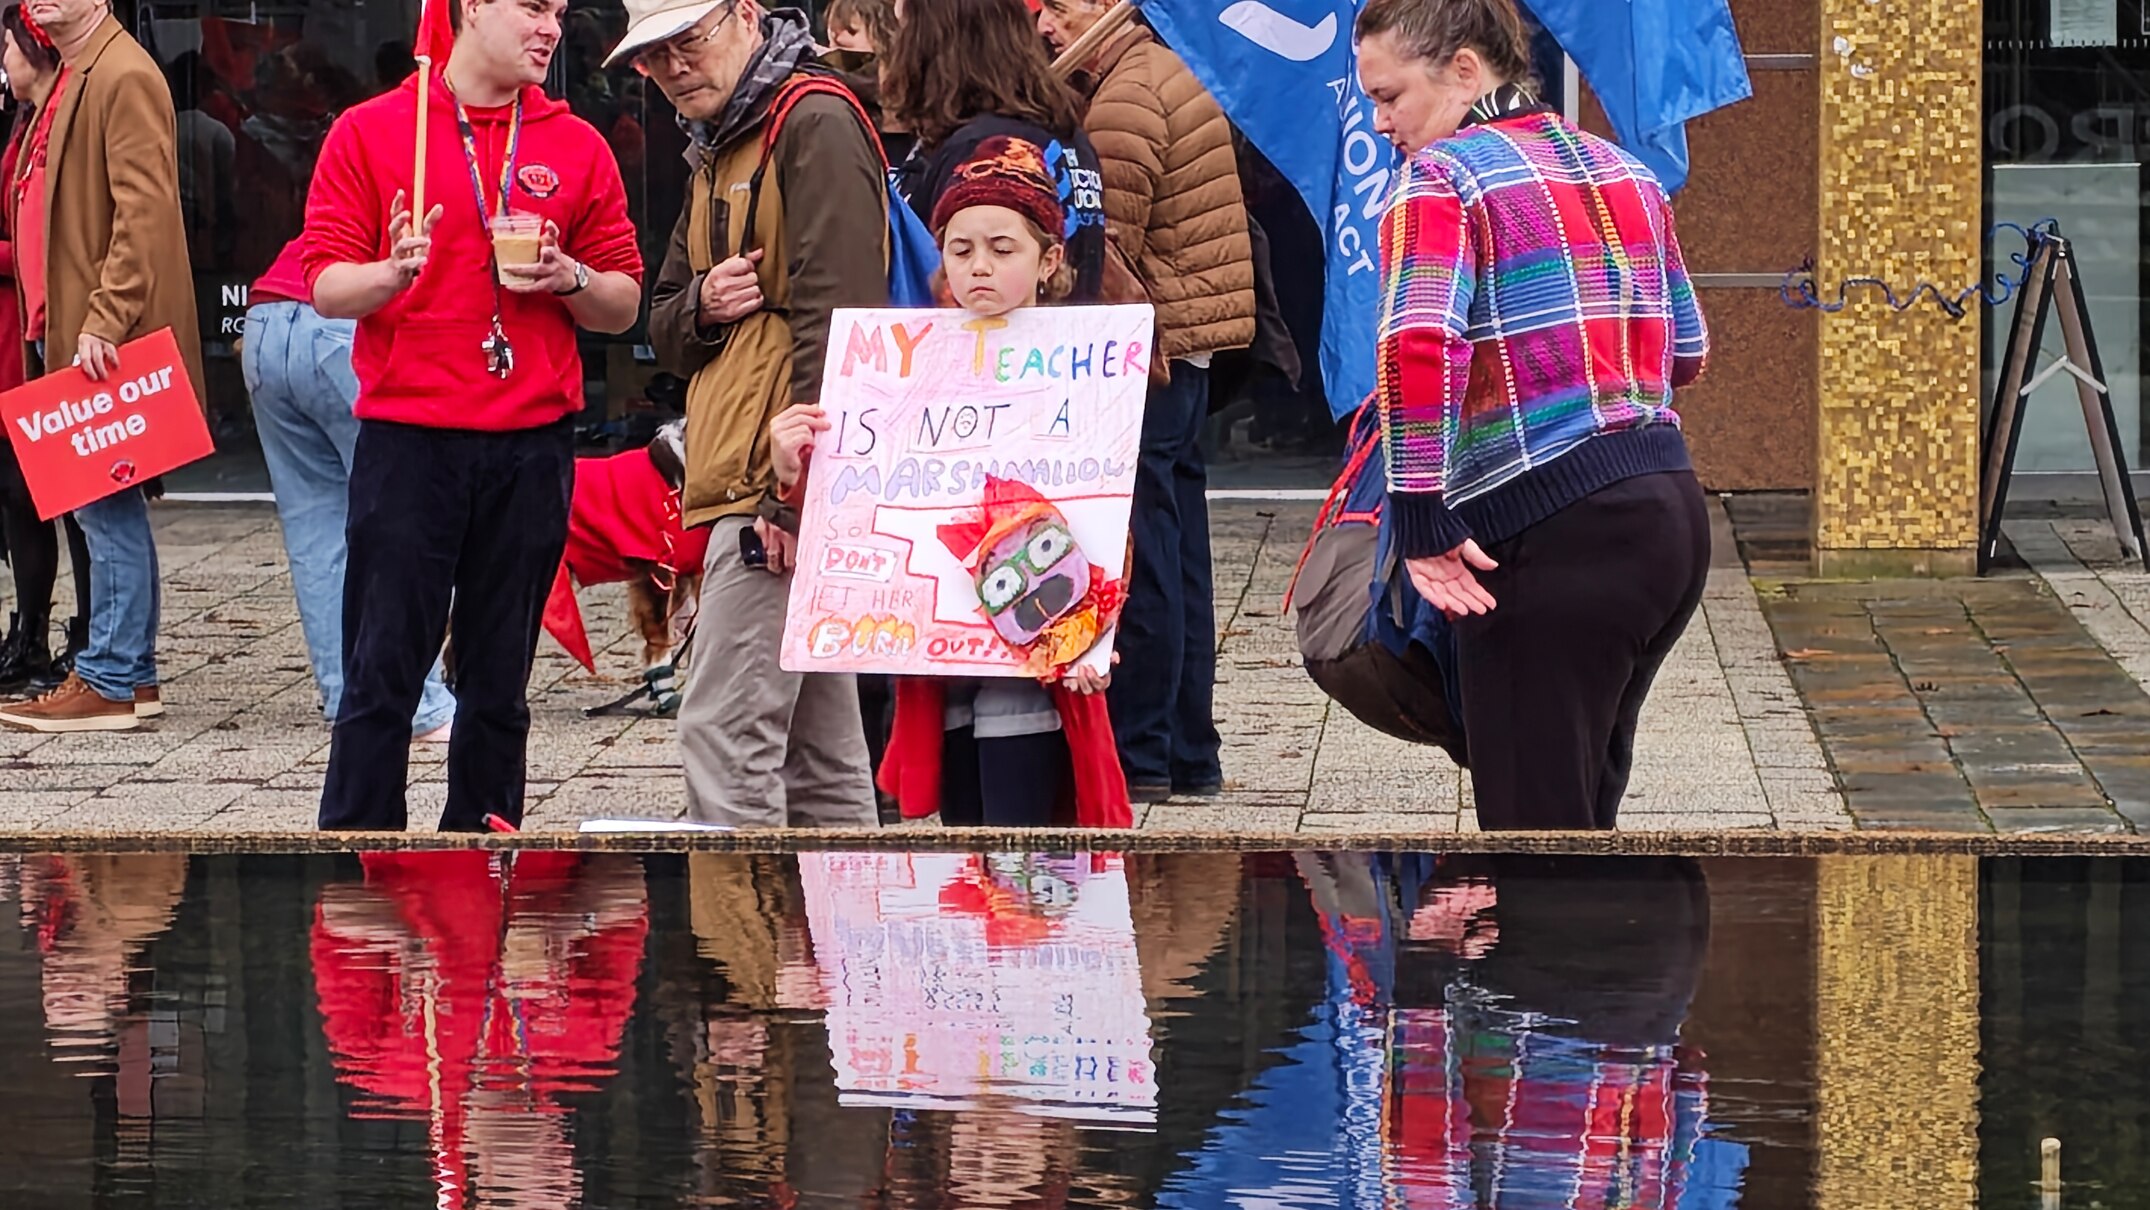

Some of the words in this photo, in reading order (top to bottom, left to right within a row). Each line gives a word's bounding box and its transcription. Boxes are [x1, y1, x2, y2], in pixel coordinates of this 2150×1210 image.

[1334, 203, 1375, 276] ACT
[221, 284, 248, 306] NI
[839, 320, 933, 378] MY
[962, 318, 1147, 383] TEACHER
[16, 392, 114, 442] Value
[119, 365, 173, 403] our
[836, 407, 876, 456] IS
[917, 402, 1011, 448] NOT
[1049, 398, 1070, 436] A
[71, 413, 147, 456] time
[831, 457, 1124, 505] MARSHMALLOW
[872, 589, 914, 611] HER
